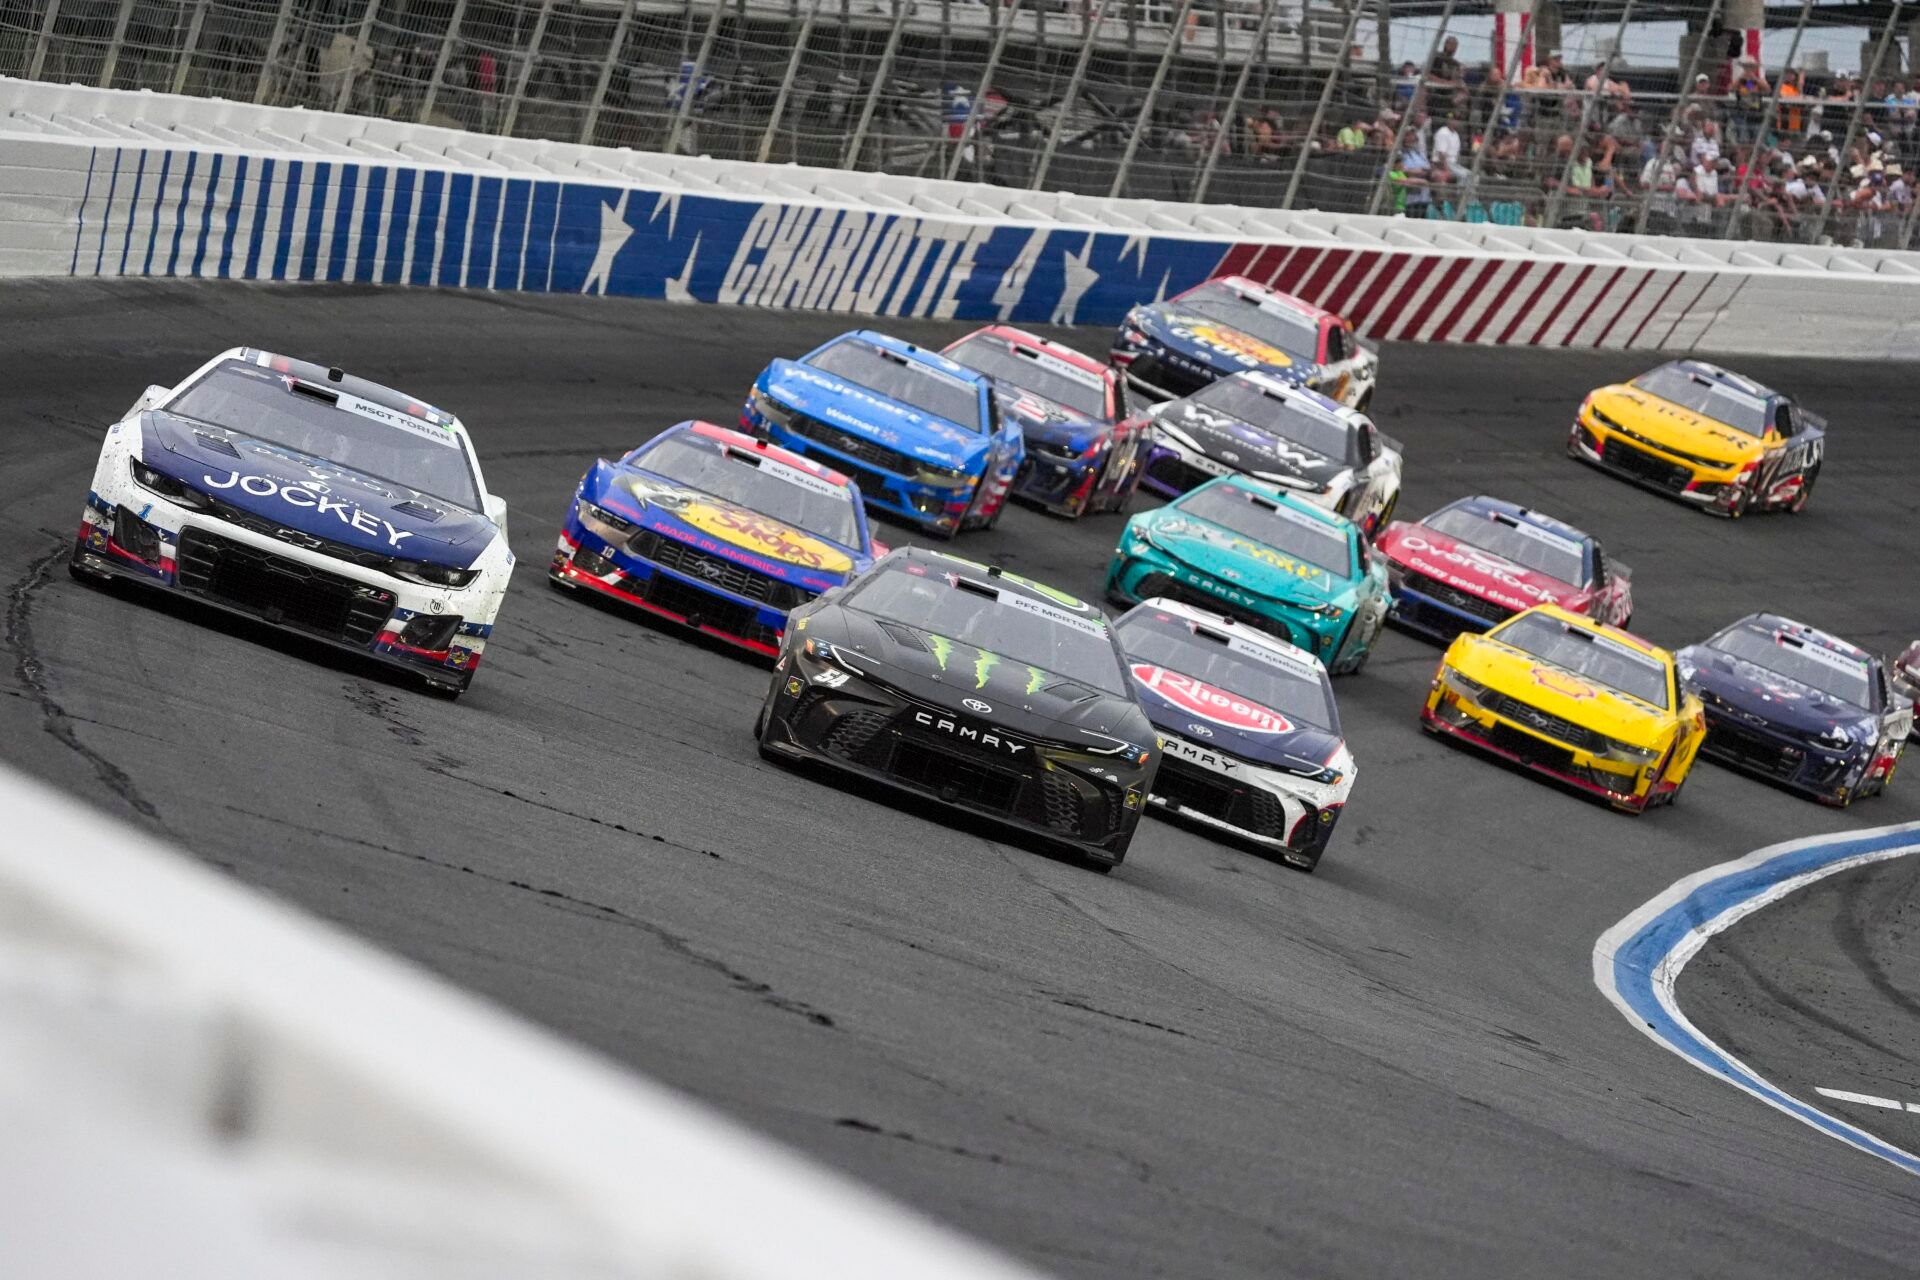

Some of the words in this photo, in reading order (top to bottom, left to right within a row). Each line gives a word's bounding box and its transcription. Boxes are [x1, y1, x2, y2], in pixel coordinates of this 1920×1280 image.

[717, 203, 994, 319] CHARLOTTE
[354, 403, 394, 420] MSGT
[398, 417, 450, 442] TORIAN
[825, 406, 880, 435] Walmart
[1196, 458, 1228, 476] CAM
[203, 471, 414, 548] JOCKEY
[653, 521, 696, 543] MADE
[700, 538, 718, 552] IN
[719, 545, 787, 578] AMERICA
[709, 512, 822, 567] Shops
[1401, 536, 1559, 603] Overstock
[1410, 556, 1449, 579] Crazy
[1449, 575, 1486, 595] good
[1187, 574, 1255, 607] CAMRY
[1015, 600, 1039, 612] PFC
[1041, 609, 1097, 633] MORTON
[1150, 667, 1284, 732] Rheem
[915, 711, 1026, 754] CAMRY
[1163, 740, 1238, 771] AMRY
